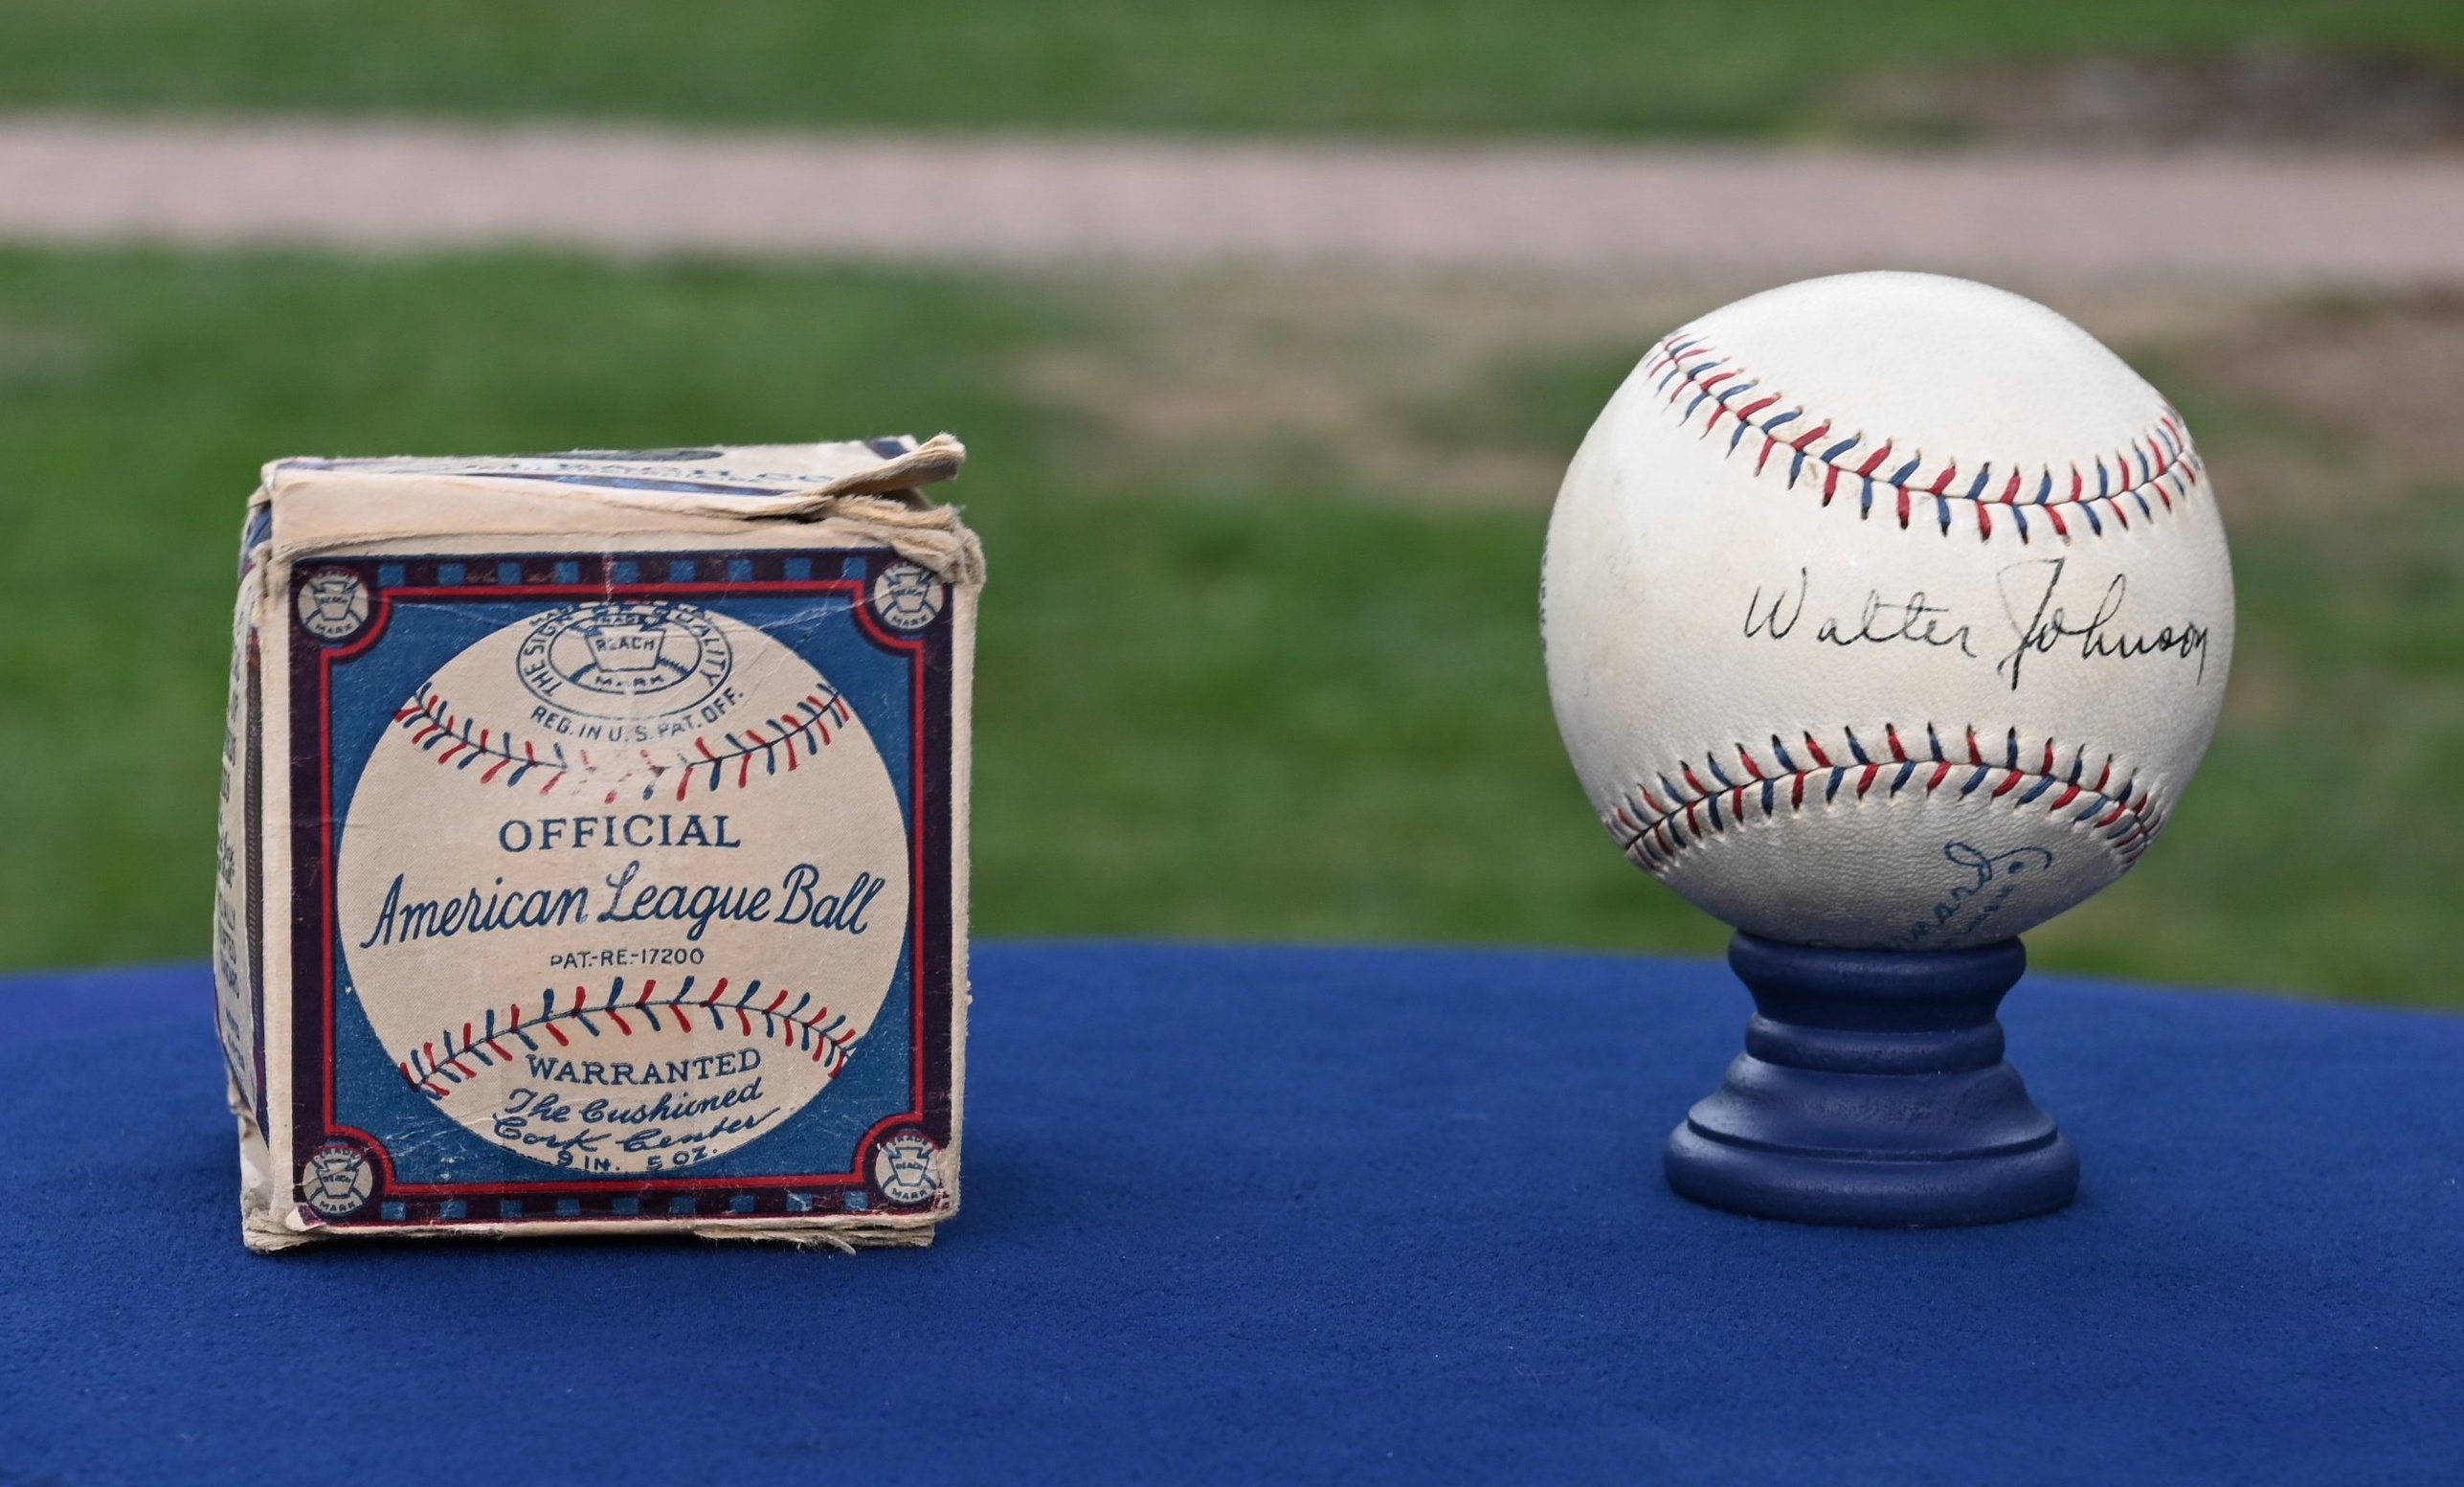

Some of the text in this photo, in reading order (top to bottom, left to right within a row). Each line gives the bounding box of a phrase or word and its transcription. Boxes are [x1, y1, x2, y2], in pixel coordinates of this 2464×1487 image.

[1744, 556, 2207, 691] Walter Johnson
[526, 660, 563, 697] THE
[530, 705, 573, 736] REG.
[579, 725, 601, 740] IN
[701, 686, 744, 725] OFF.
[499, 815, 741, 852] OFFICIAL
[359, 860, 885, 949] American League Ball
[526, 1048, 761, 1086] WARRANTED
[504, 1076, 764, 1125] The Cushioned
[492, 1107, 781, 1153] Cork Center
[556, 1147, 718, 1171] 9 IN. 5 OZ.
